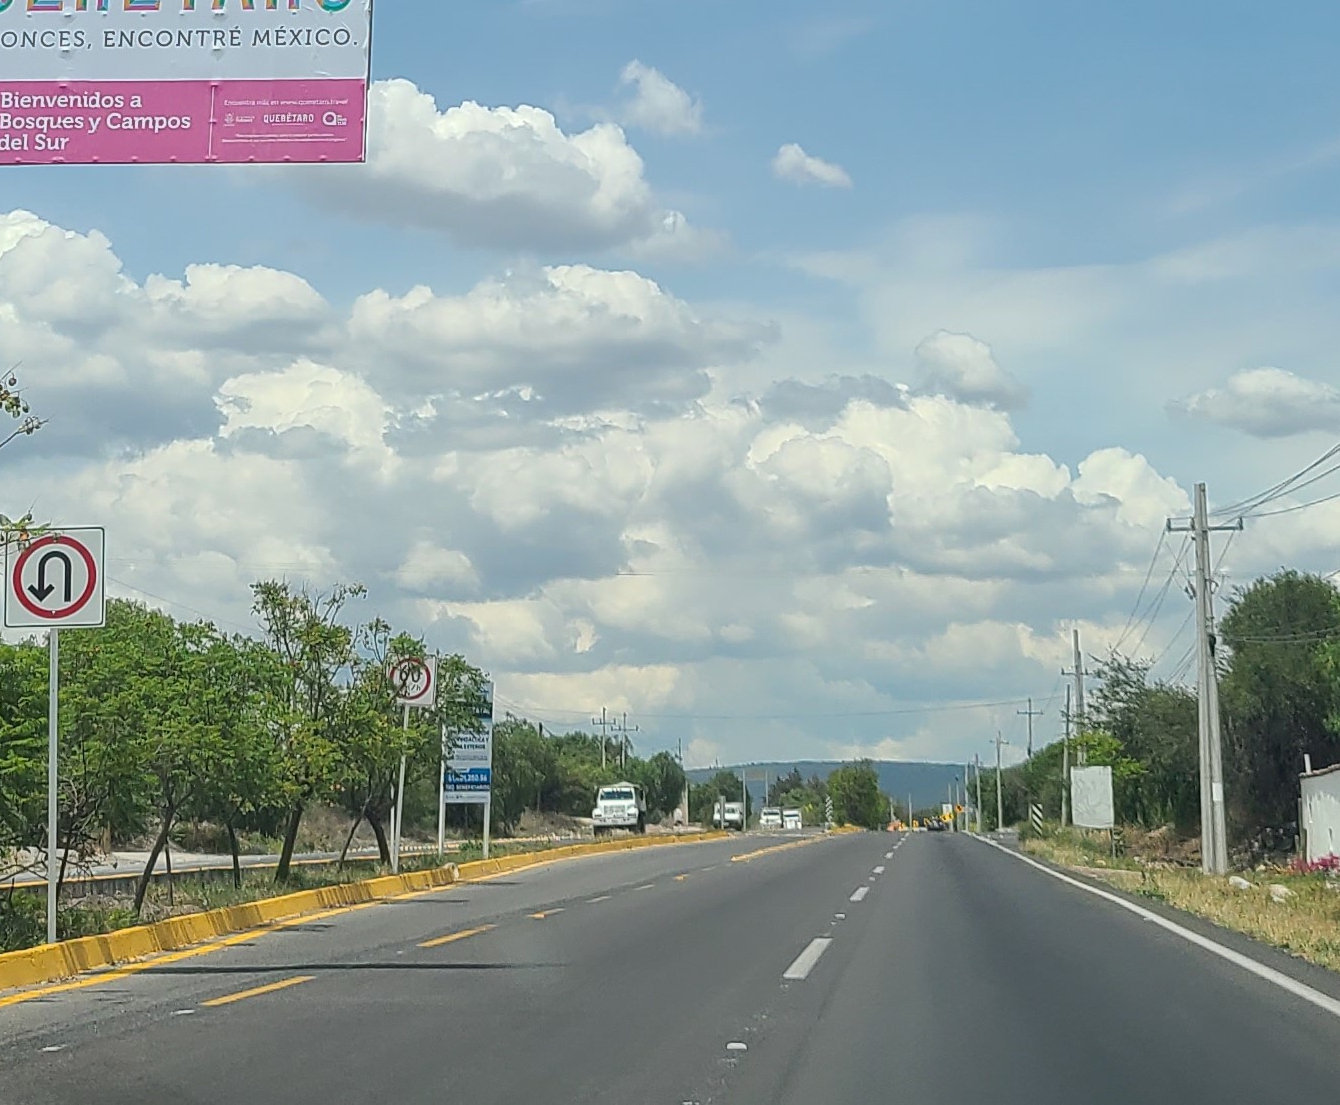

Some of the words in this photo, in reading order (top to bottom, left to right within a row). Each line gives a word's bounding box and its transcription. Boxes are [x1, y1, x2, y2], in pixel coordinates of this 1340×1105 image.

[103, 26, 241, 47] ENCONTRÉ
[252, 26, 358, 47] MÉXICO.
[0, 91, 124, 109] Bienvenidos
[129, 95, 142, 108] a
[0, 112, 84, 132] Bosques
[87, 116, 101, 134] y
[106, 112, 191, 131] Campos
[34, 134, 69, 151] Sur
